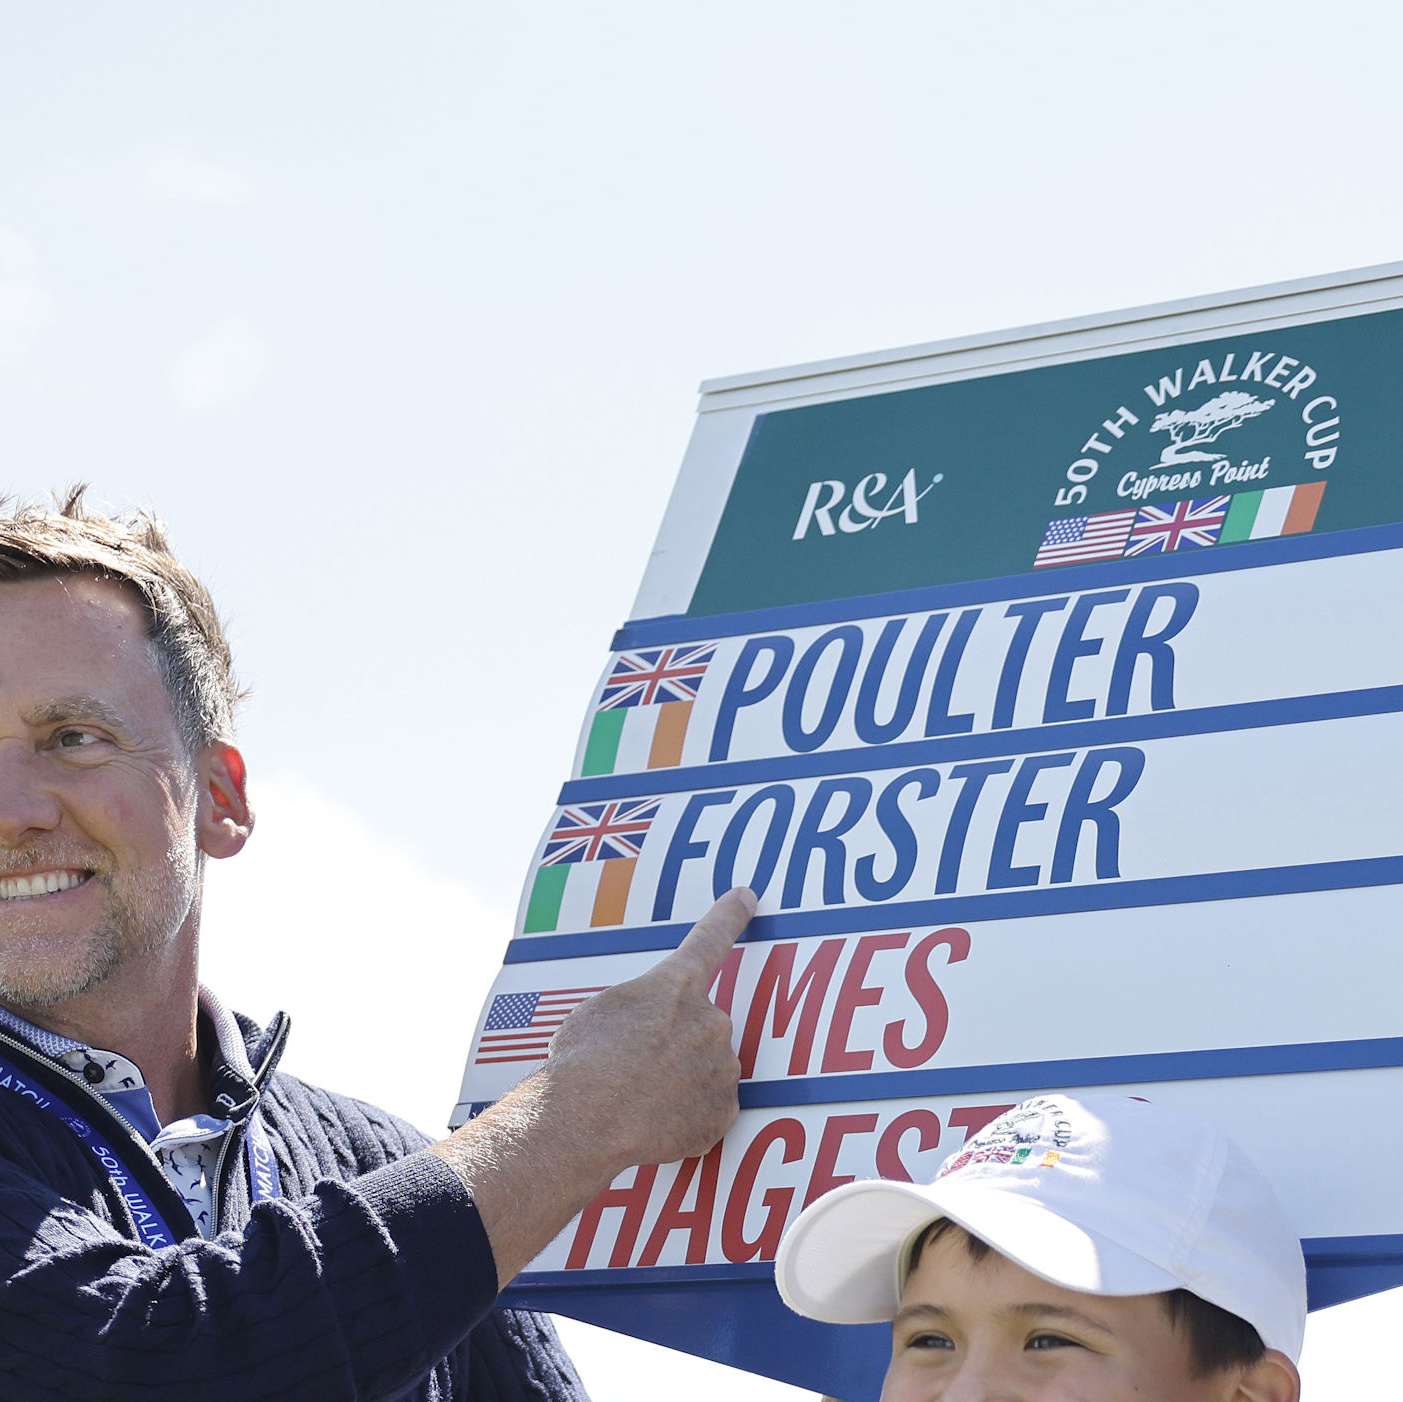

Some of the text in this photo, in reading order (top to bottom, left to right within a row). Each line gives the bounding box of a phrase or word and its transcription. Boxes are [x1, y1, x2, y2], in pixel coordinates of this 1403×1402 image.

[792, 468, 944, 541] R&A
[1054, 351, 1340, 506] 50TH WALKER CUP
[1116, 456, 1271, 500] Cypress Point
[708, 582, 1200, 763] POULTER
[651, 746, 1146, 922] FORSTER
[706, 926, 971, 1080] MES
[91, 1145, 168, 1248] 50th WALK
